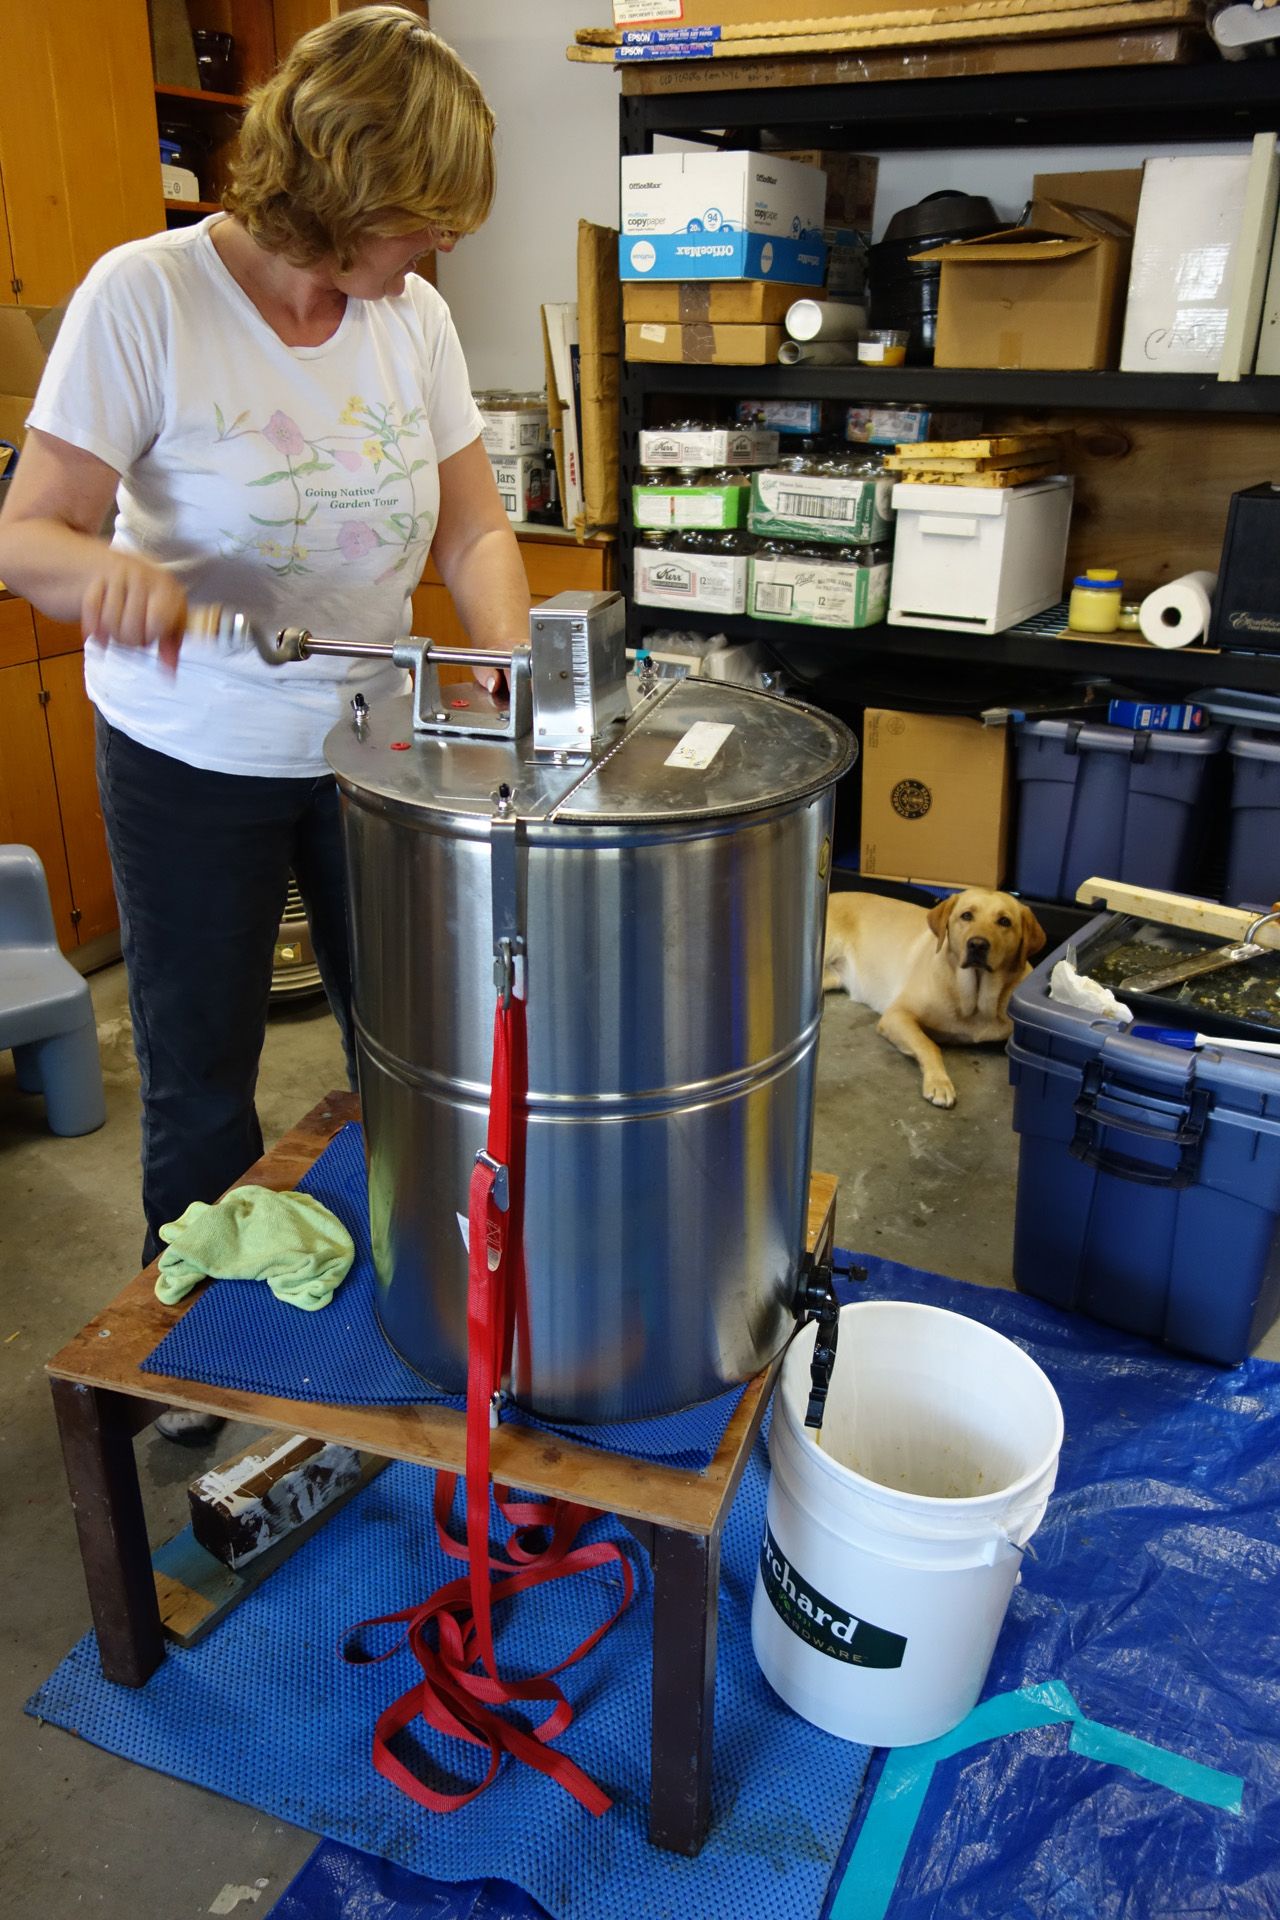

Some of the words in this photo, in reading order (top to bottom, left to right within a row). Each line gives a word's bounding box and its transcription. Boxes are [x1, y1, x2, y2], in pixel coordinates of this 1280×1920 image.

[627, 32, 650, 43] EPSON
[620, 46, 644, 56] EPSON
[628, 182, 660, 190] OfficeMax
[707, 213, 718, 223] 94
[675, 245, 734, 257] OfficeMax
[496, 469, 516, 484] Jars
[305, 488, 337, 498] Going
[340, 487, 375, 497] Native
[329, 500, 370, 509] Garden
[373, 498, 399, 507] Tour
[656, 567, 682, 581] Kerr
[795, 573, 816, 588] Ball
[818, 596, 826, 606] 12
